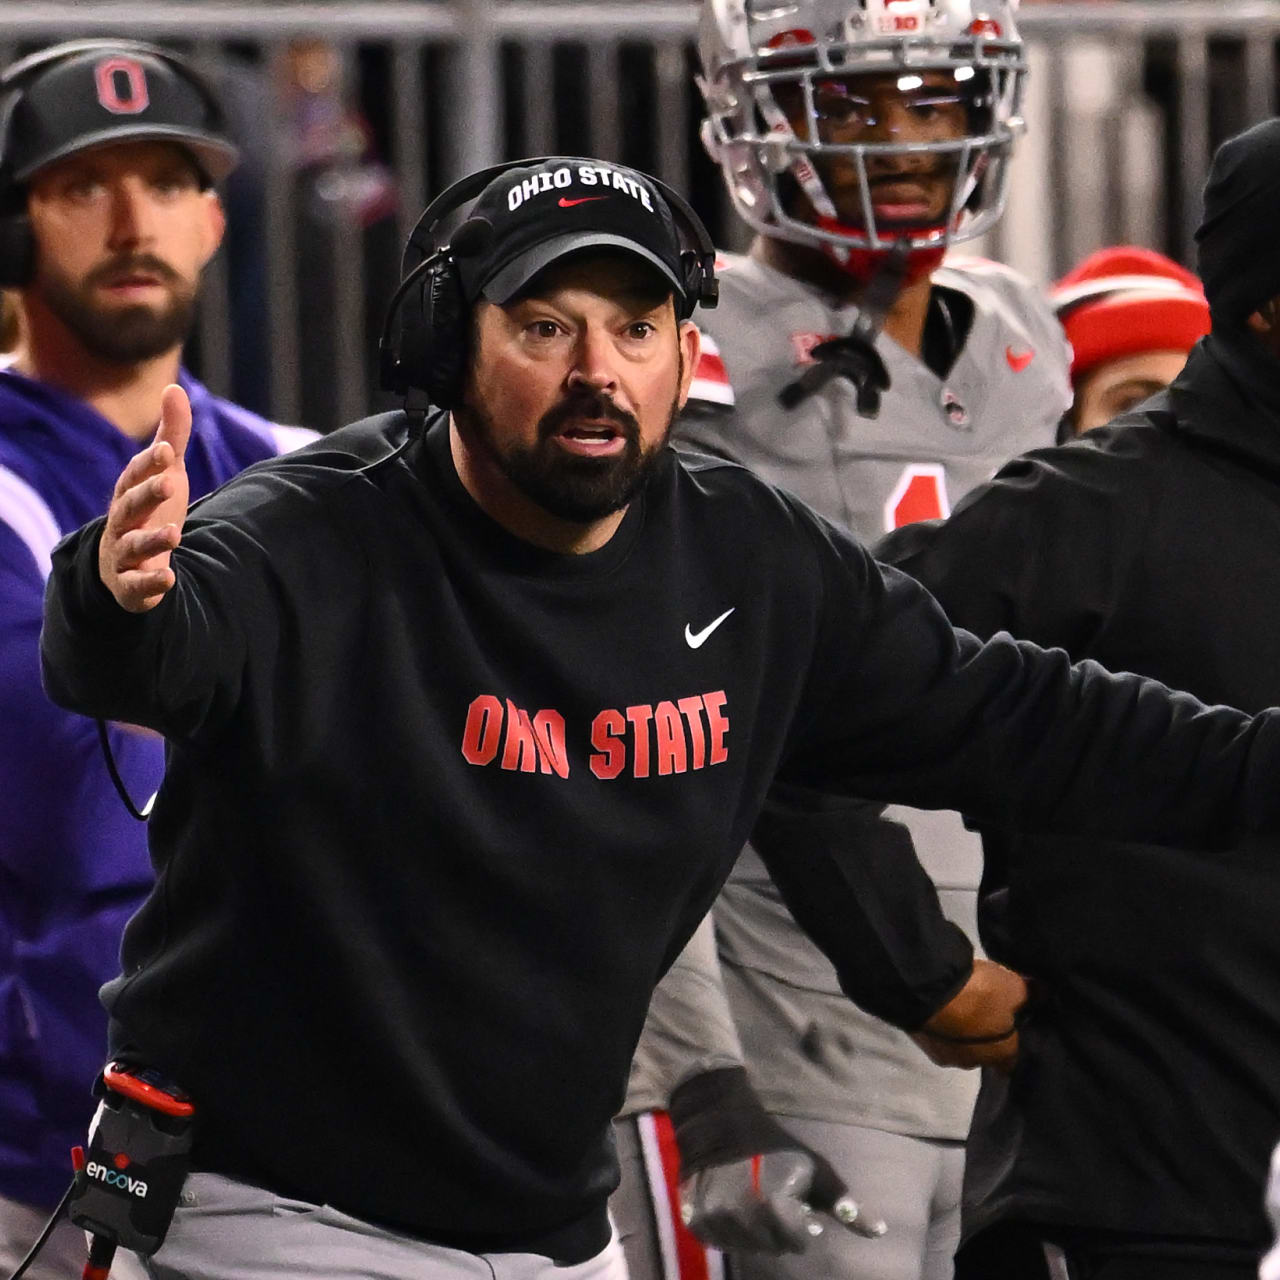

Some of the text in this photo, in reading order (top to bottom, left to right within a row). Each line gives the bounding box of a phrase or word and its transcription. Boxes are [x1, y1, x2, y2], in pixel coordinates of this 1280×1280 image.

[94, 57, 150, 115] O
[508, 166, 654, 213] OHIO STATE
[589, 690, 730, 780] STATE
[86, 1160, 149, 1198] encova
